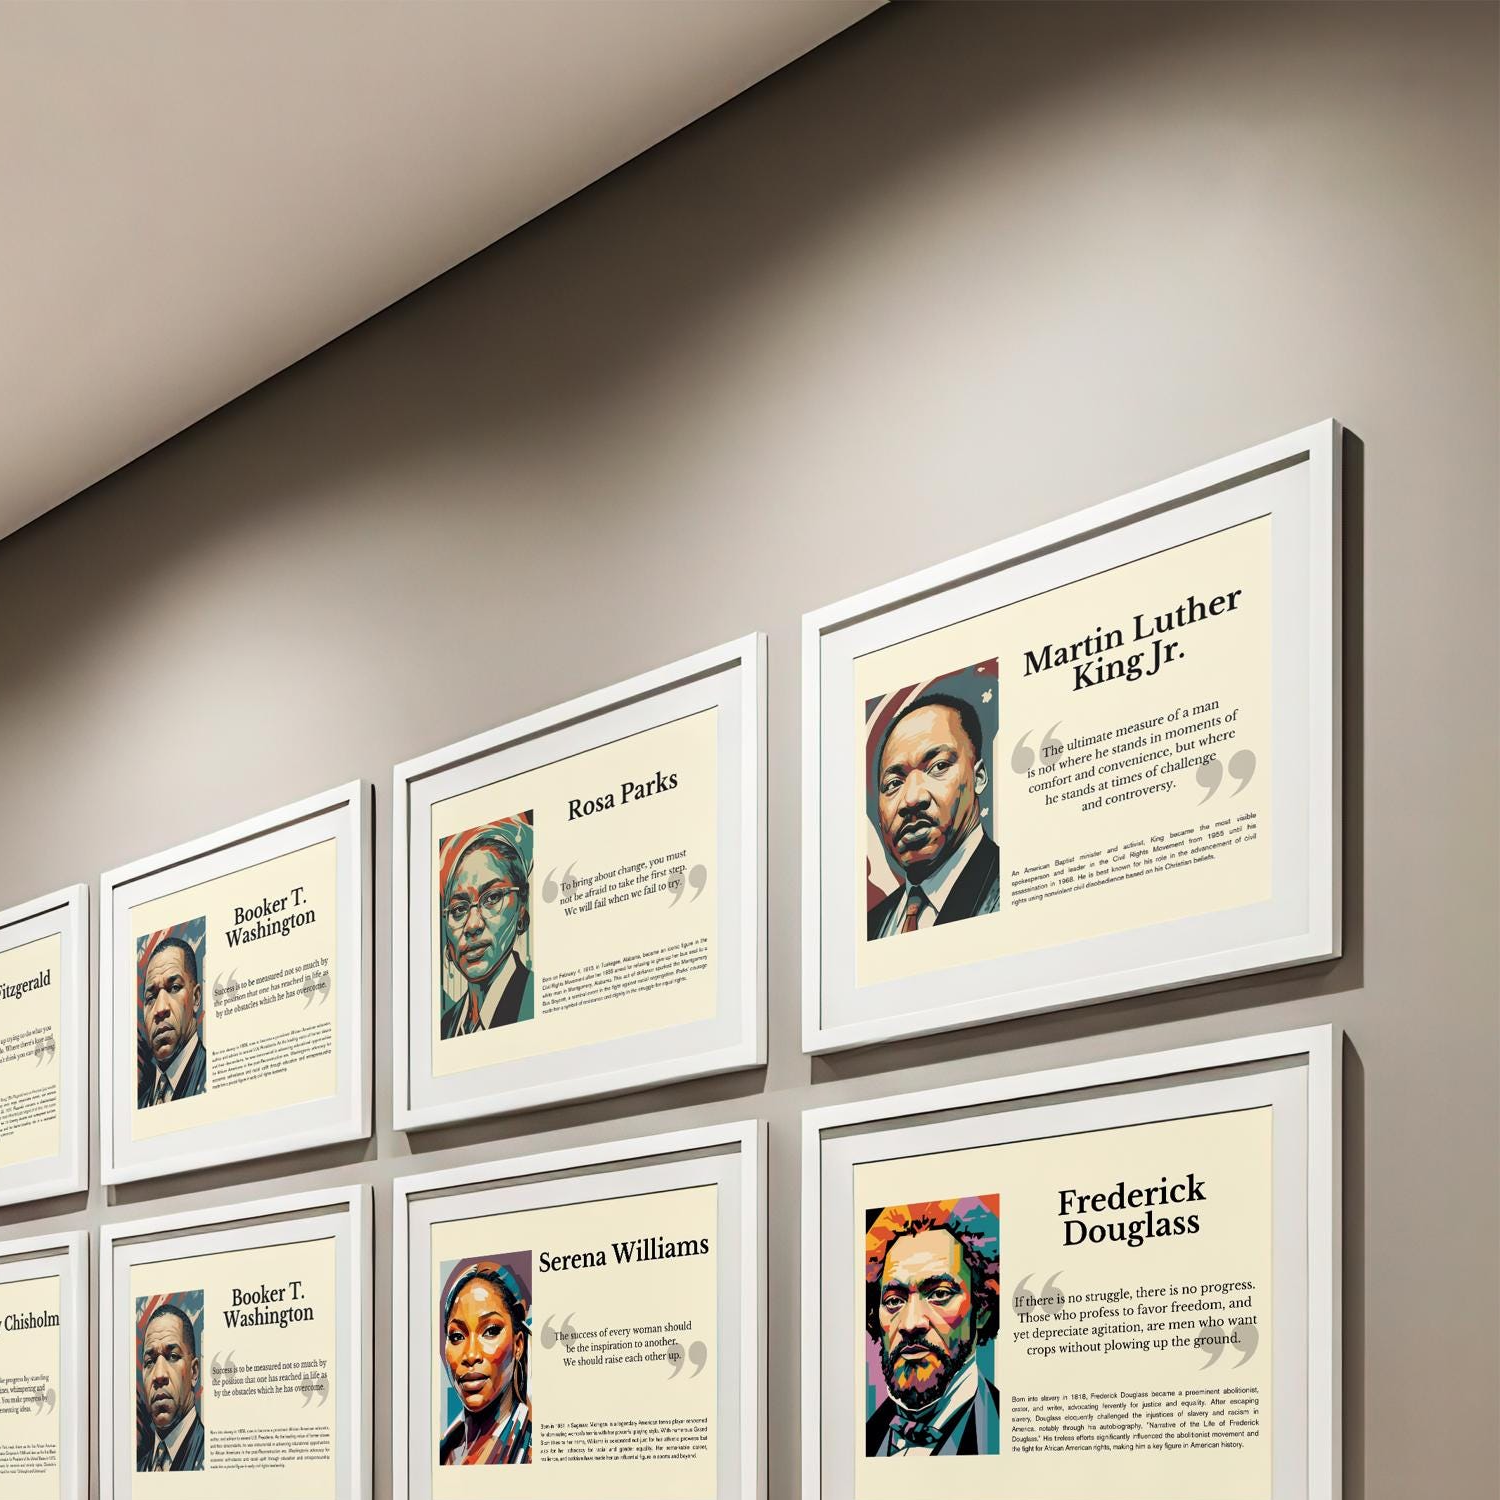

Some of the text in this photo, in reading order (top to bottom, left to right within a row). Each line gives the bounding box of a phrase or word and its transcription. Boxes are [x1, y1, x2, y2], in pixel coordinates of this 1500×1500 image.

[1023, 589, 1241, 676] Martin Luther
[1073, 639, 1184, 691] King Jr.
[1027, 708, 1238, 778] is not where he stands in moments of
[1042, 700, 1219, 757] The ultimate measure of a man
[1028, 730, 1235, 793] comfort and convenience, but where
[1045, 752, 1216, 805] he stands at times of challenge
[568, 771, 677, 821] Rosa Parks
[1082, 780, 1176, 811] and controversy.
[561, 850, 686, 891] To bring about change, you must
[1011, 883, 1048, 896] assassination
[1095, 868, 1109, 876] best
[1111, 864, 1130, 872] known
[1190, 839, 1232, 854] advancement
[1243, 832, 1256, 841] civil
[234, 886, 306, 925] Booker T.
[225, 910, 315, 947] Washington
[1058, 1173, 1206, 1216] Frederick
[1063, 1210, 1199, 1247] Douglass
[539, 1236, 708, 1272] Serena Williams
[232, 1281, 304, 1306] Booker T.
[1014, 1281, 1255, 1308] If there is no struggle, there is no progress.
[1017, 1295, 1252, 1323] Those who profess to favor freedom, and
[4, 1310, 60, 1331] Chisholm
[223, 1305, 314, 1328] Washington
[554, 1320, 691, 1341] The success of every woman should
[1013, 1315, 1257, 1342] yet depreciate agitation, are men who want
[1027, 1331, 1241, 1357] crops without plowing up the ground.
